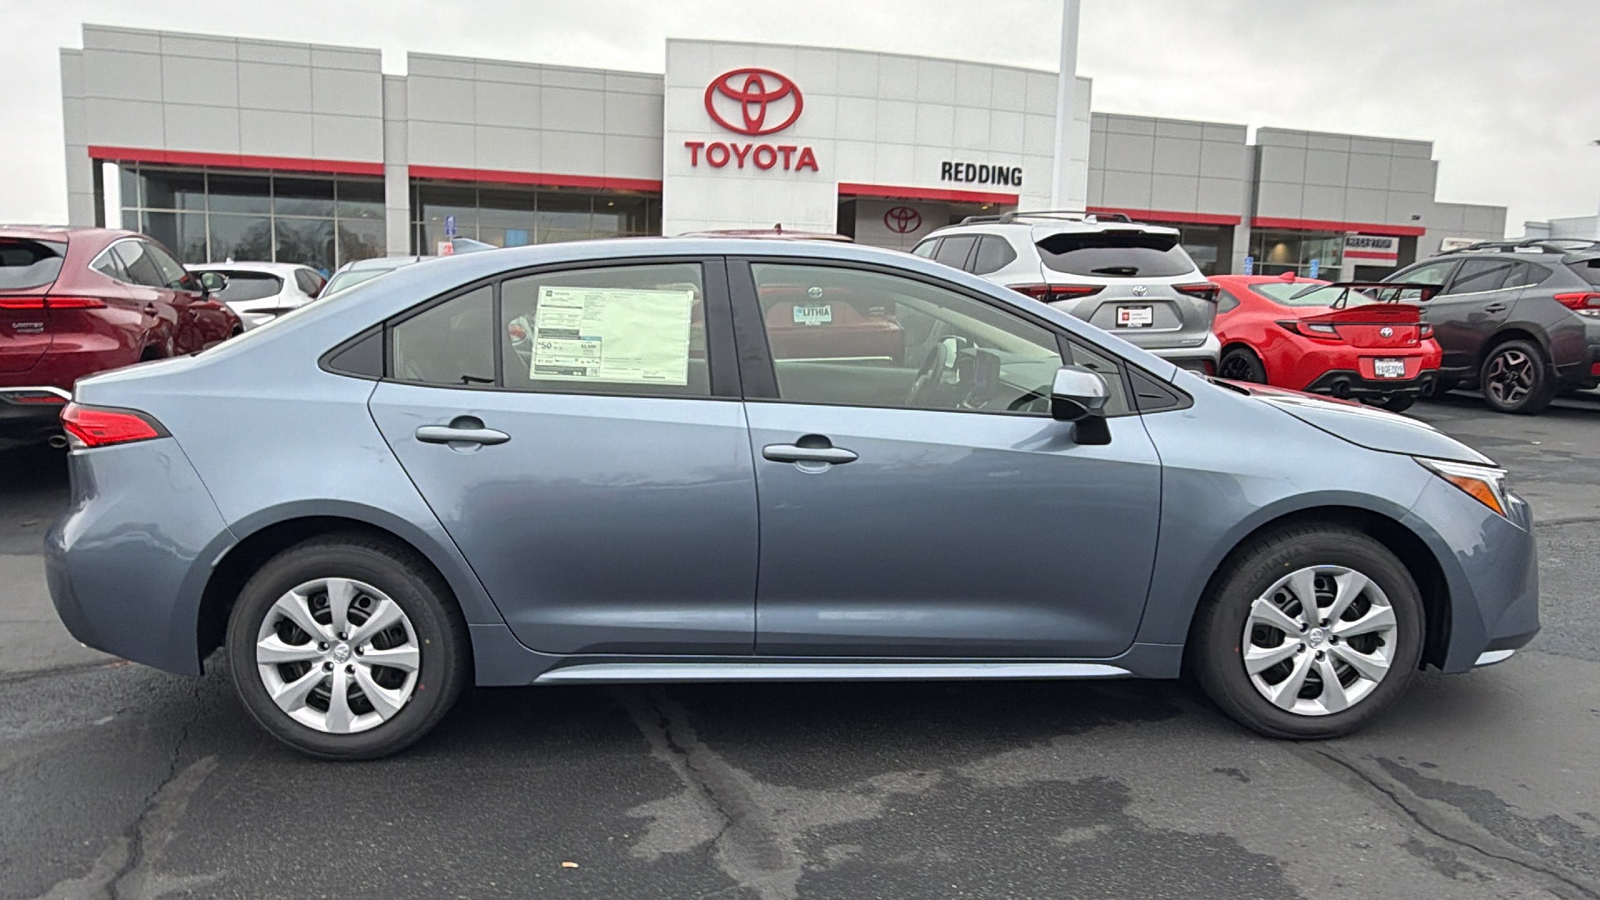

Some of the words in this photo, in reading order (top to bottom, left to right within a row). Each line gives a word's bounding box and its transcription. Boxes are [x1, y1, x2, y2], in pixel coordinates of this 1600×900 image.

[684, 141, 819, 172] TOYOTA
[941, 161, 1022, 187] REDDING
[802, 307, 830, 317] LITHIA
